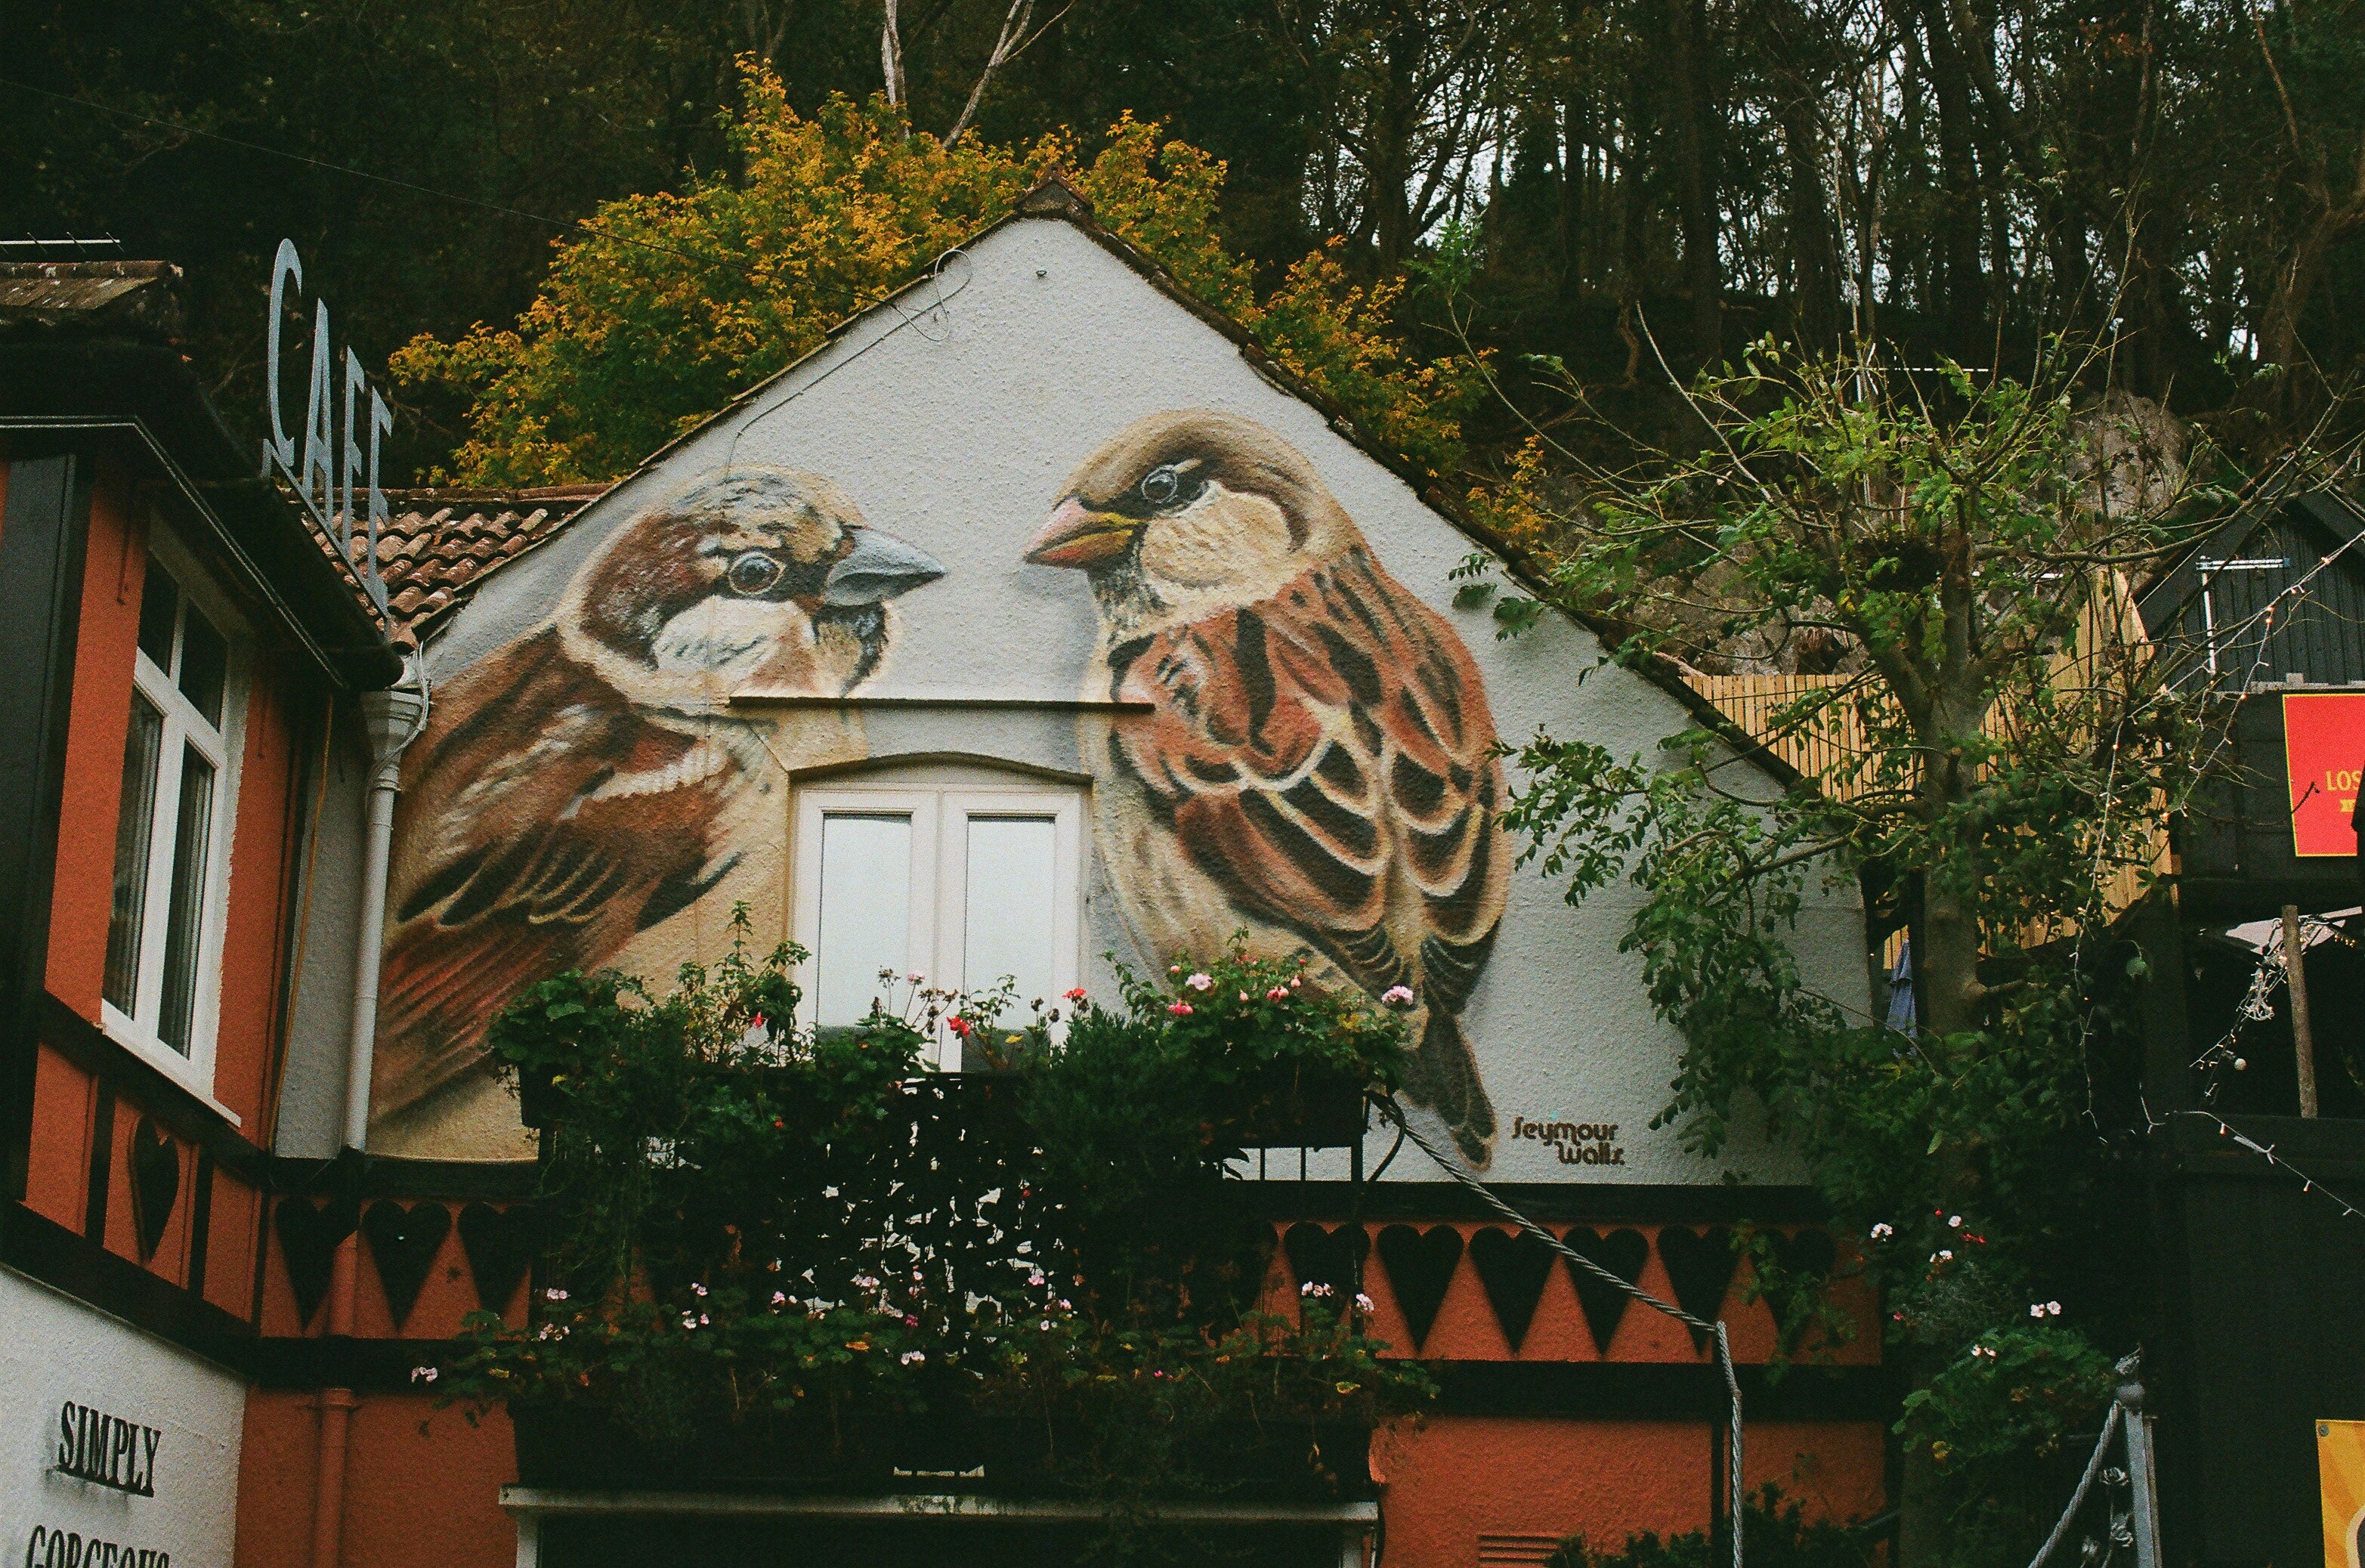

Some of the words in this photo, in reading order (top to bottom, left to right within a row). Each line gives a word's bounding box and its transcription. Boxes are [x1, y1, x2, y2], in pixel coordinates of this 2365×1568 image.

[267, 238, 392, 616] CAFE
[1511, 1116, 1619, 1147] Seymour
[58, 1401, 162, 1498] SIMPLY
